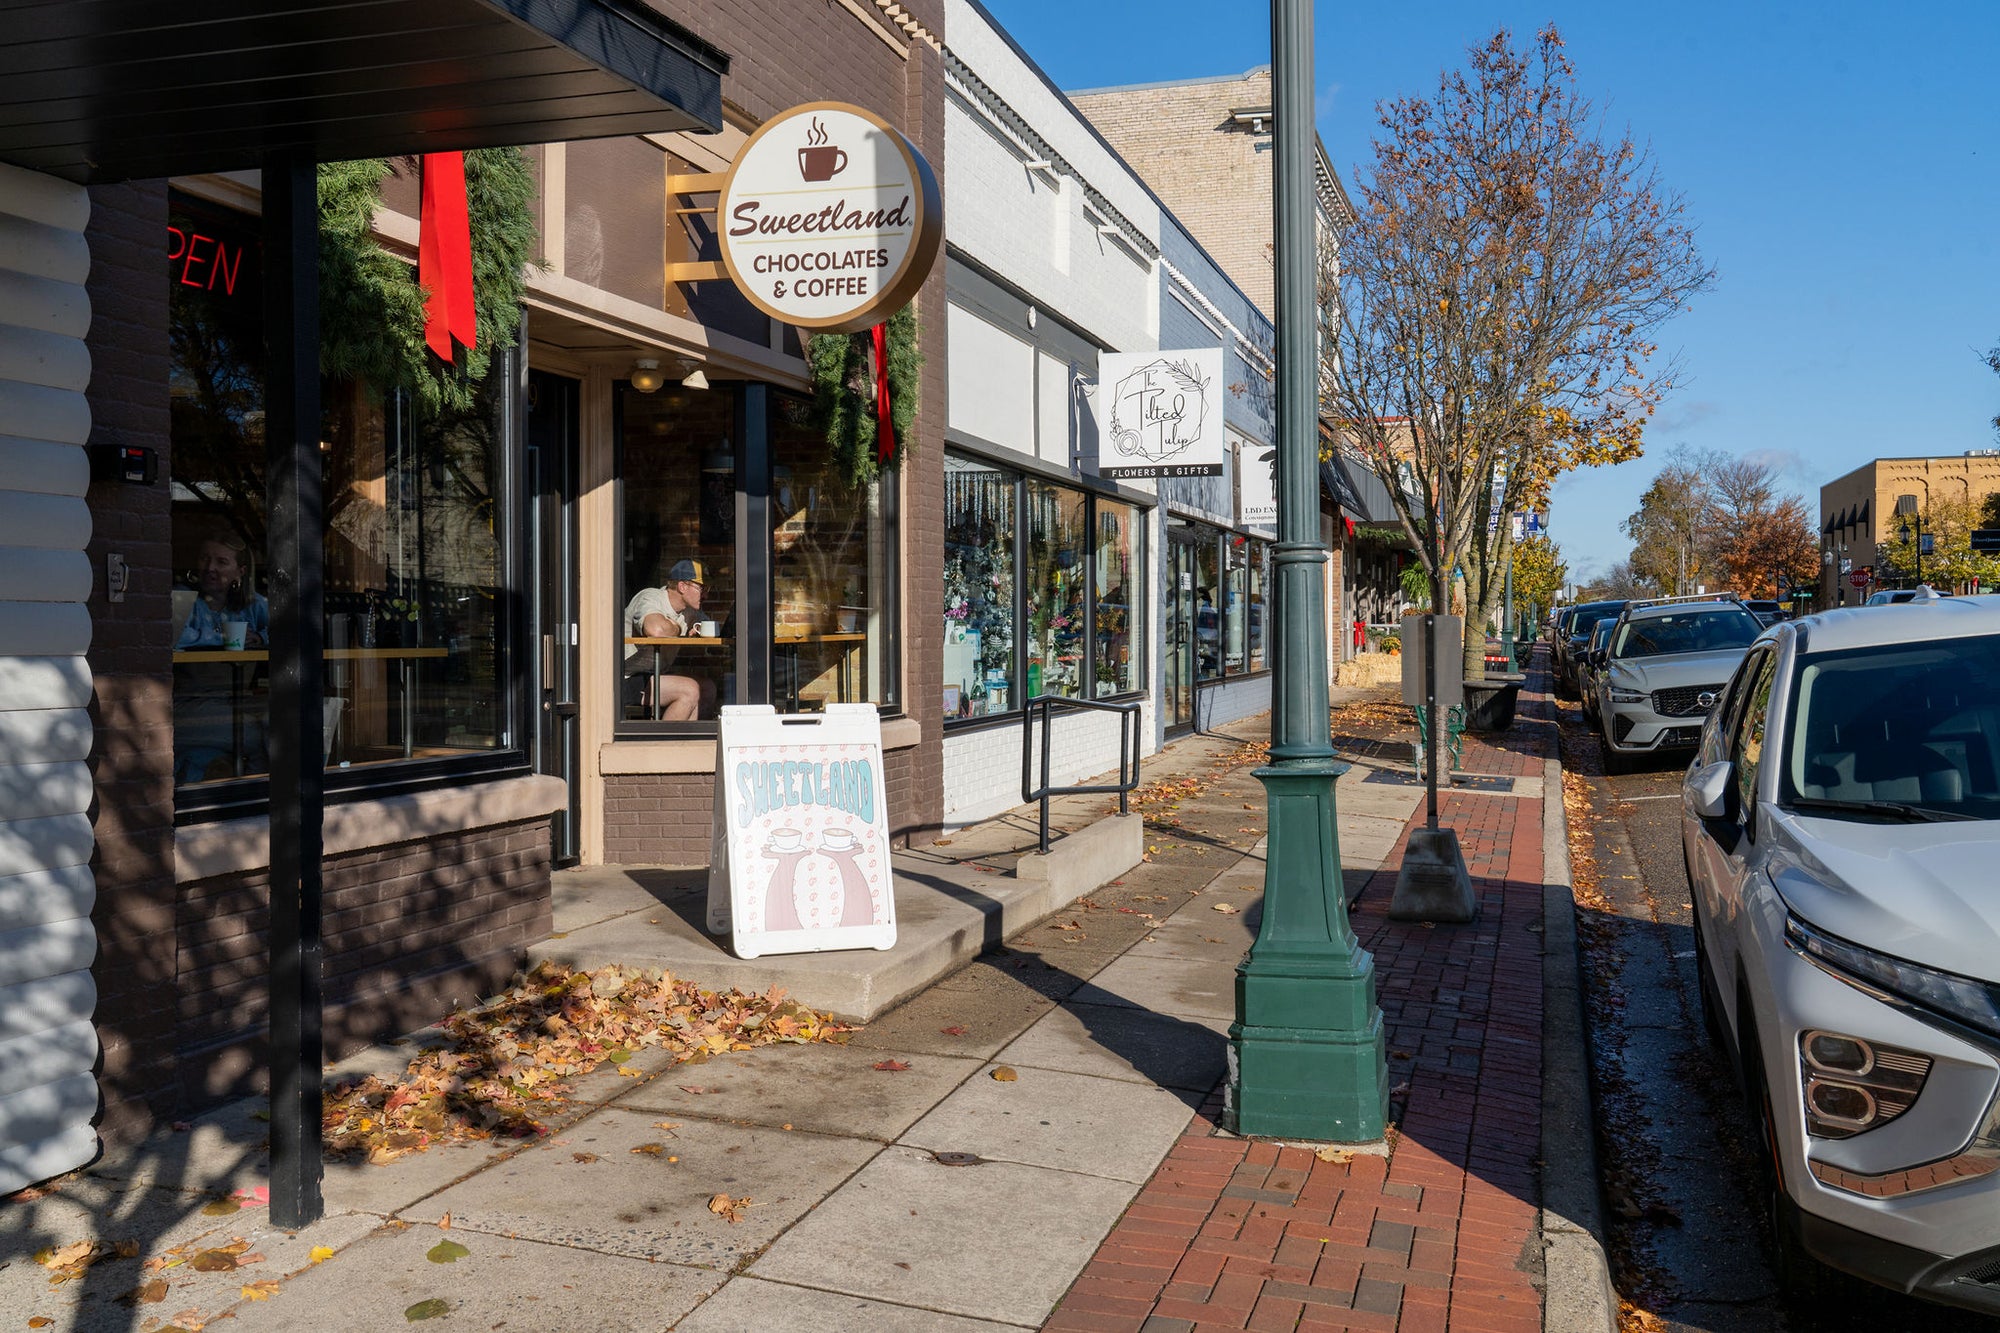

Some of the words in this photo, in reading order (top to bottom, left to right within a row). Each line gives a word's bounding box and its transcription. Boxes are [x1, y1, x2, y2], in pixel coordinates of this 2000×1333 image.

[729, 195, 909, 237] Sweetland
[167, 226, 242, 296] PEN
[753, 248, 889, 274] CHOCOLATES
[773, 280, 788, 299] &
[794, 276, 867, 298] COFFEE
[1137, 369, 1158, 391] The
[1124, 388, 1187, 431] Tilted
[1146, 417, 1189, 454] Tulip
[1111, 468, 1156, 477] FLOWERS
[1163, 467, 1169, 475] &
[1176, 466, 1209, 475] GIFTS
[1850, 575, 1868, 583] STOP
[736, 758, 874, 828] SWEETLAND
